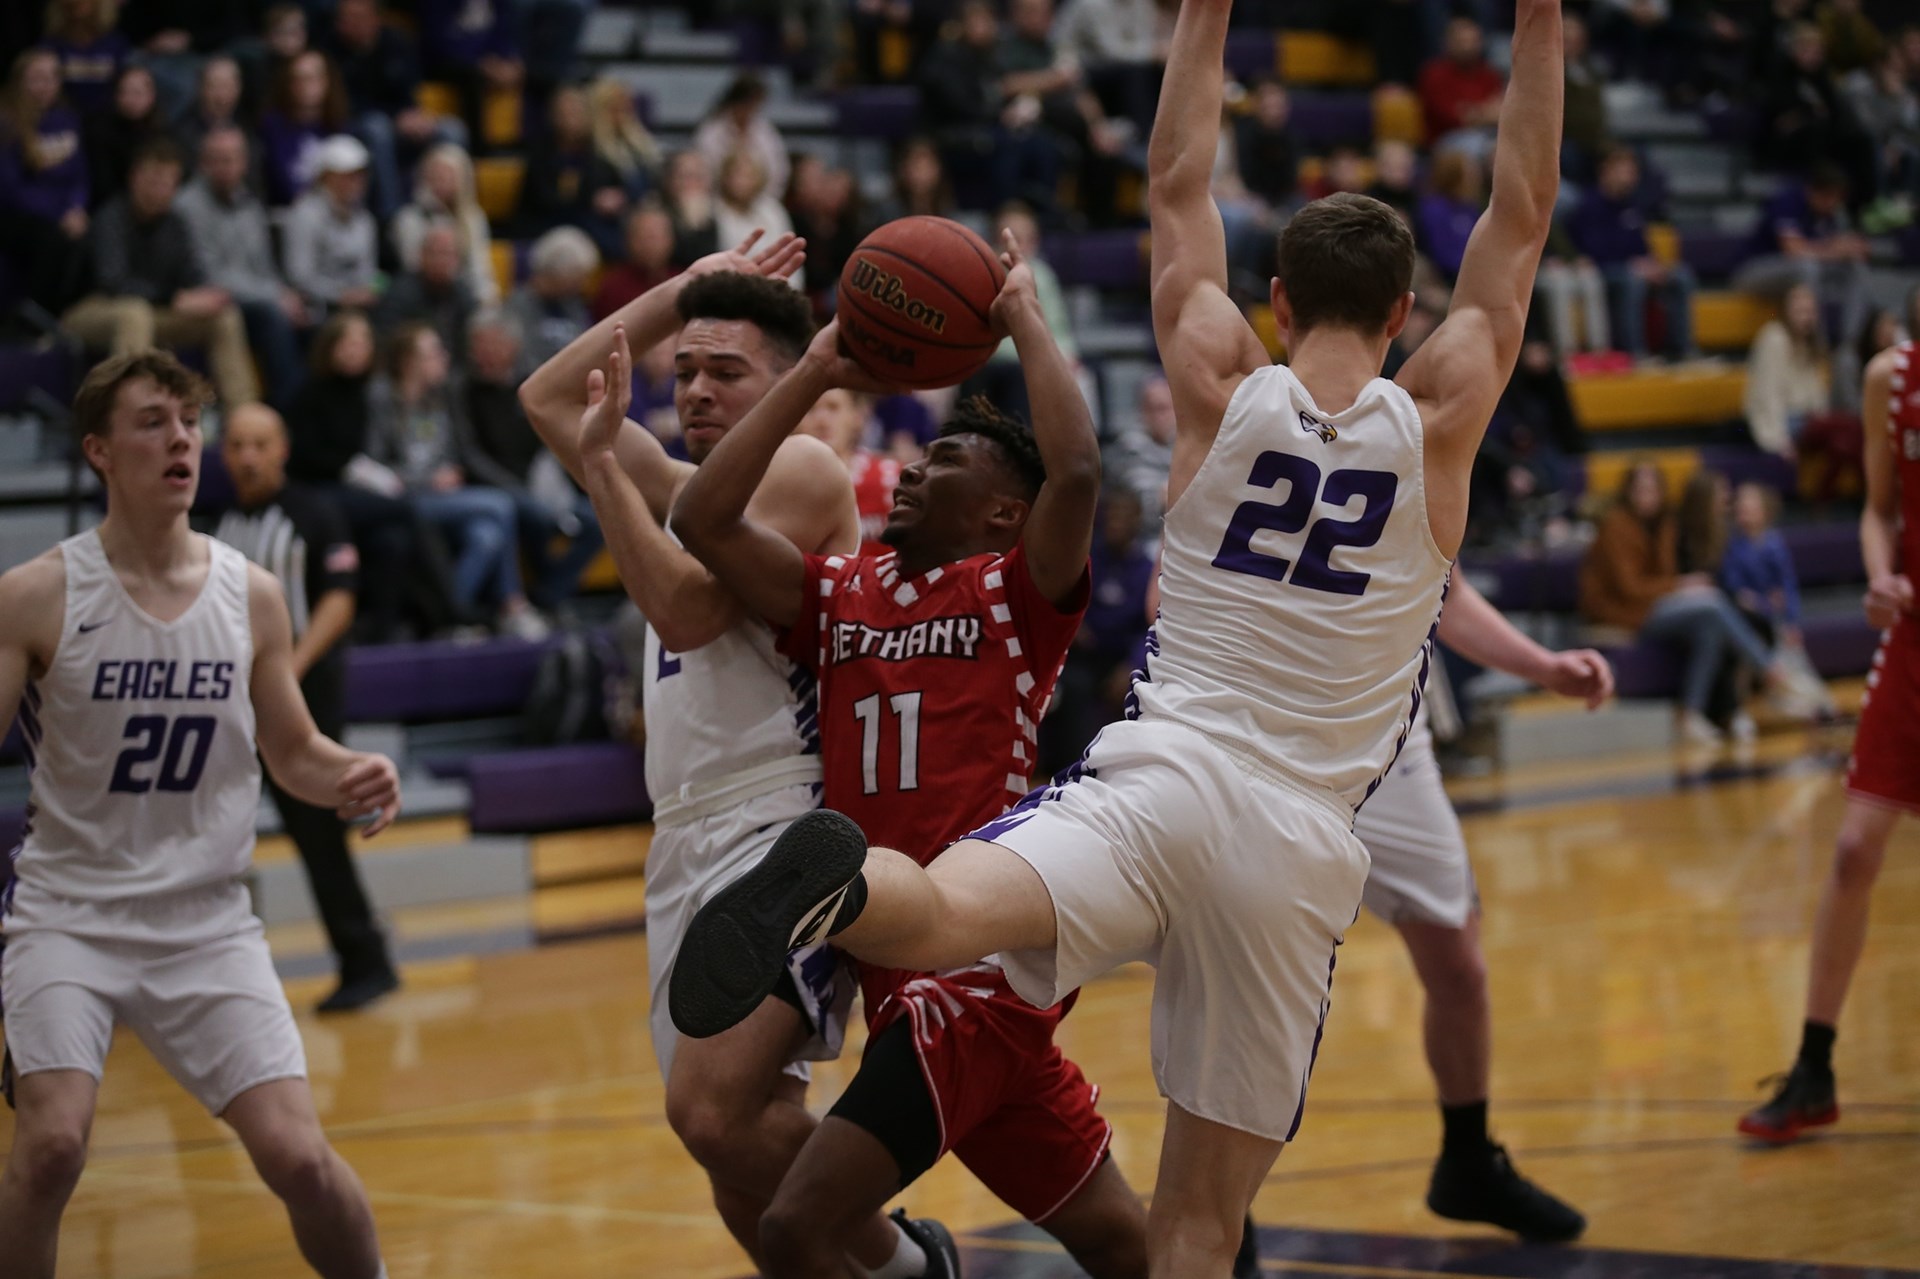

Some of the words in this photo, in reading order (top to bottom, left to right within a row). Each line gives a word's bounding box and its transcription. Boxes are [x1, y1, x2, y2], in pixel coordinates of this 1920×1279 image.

[852, 257, 946, 335] Wilson
[1211, 450, 1399, 596] 22
[92, 660, 234, 700] EAGLES
[109, 716, 217, 793] 20
[853, 691, 923, 796] 11
